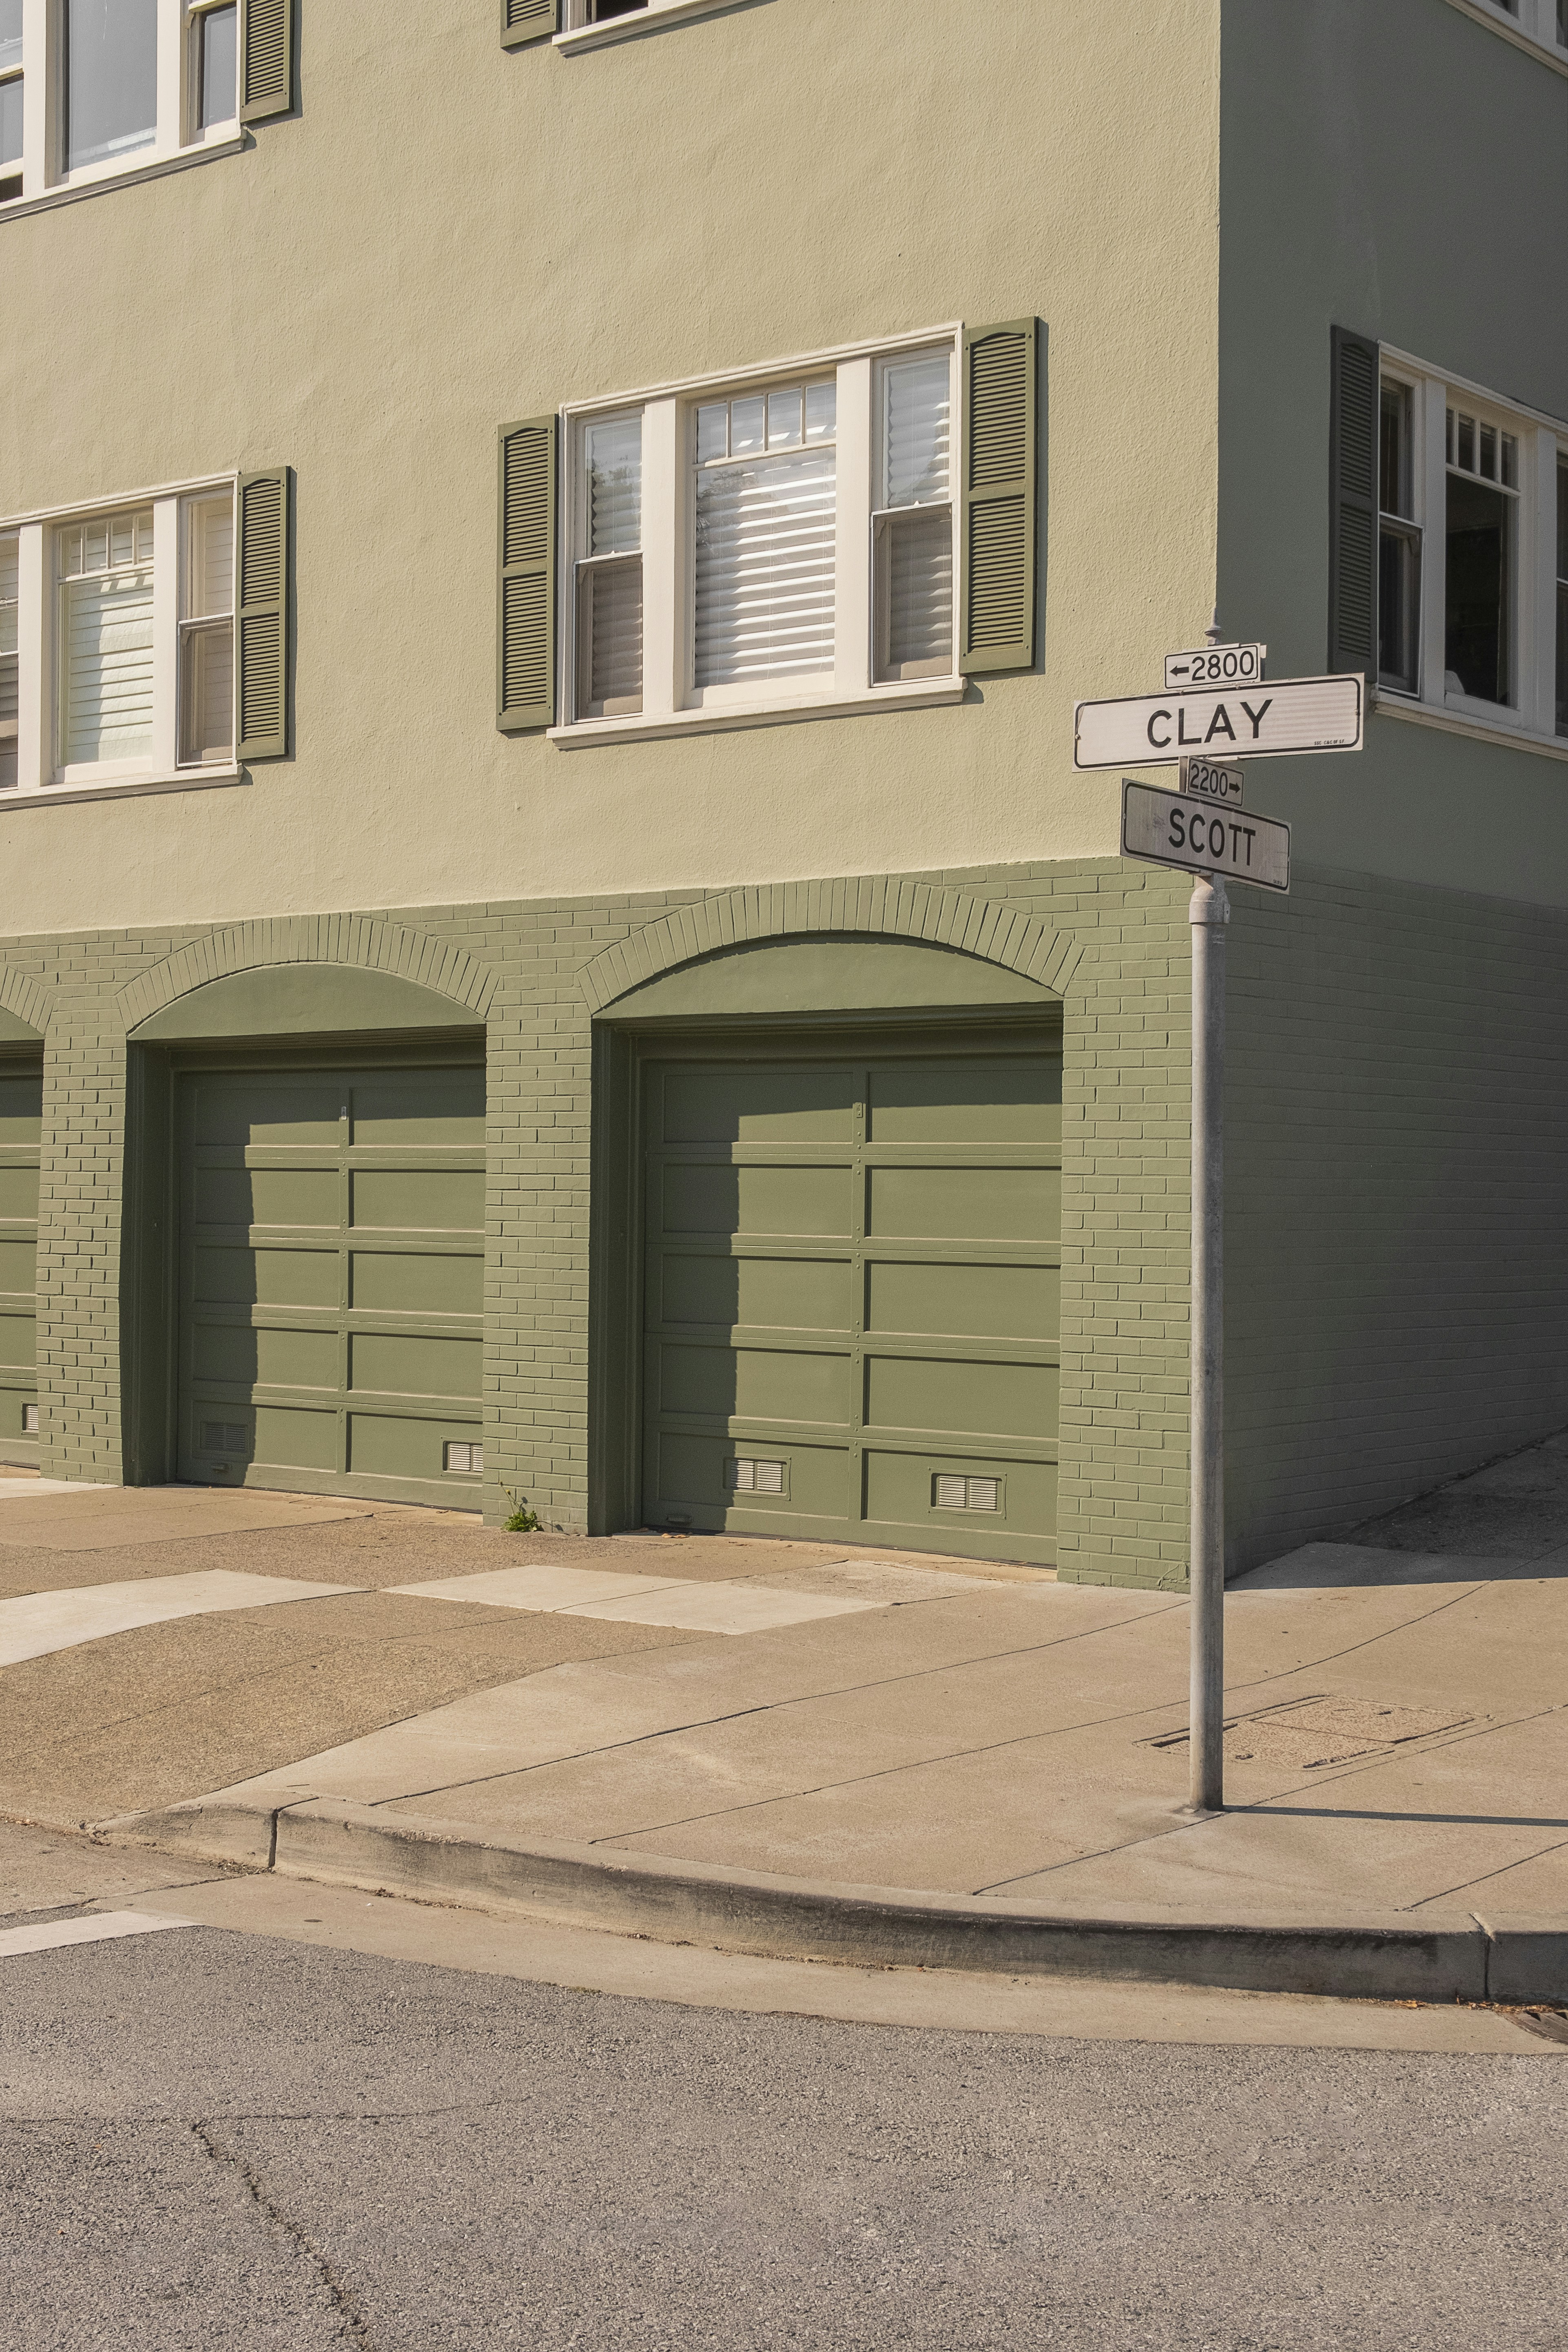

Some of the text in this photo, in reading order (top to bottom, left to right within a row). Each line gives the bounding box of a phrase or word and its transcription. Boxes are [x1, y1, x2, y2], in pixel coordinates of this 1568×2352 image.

[1192, 651, 1254, 681] 2800
[1147, 699, 1273, 748] CLAY
[1190, 763, 1228, 797] 2200
[1168, 808, 1256, 866] SCOTT
